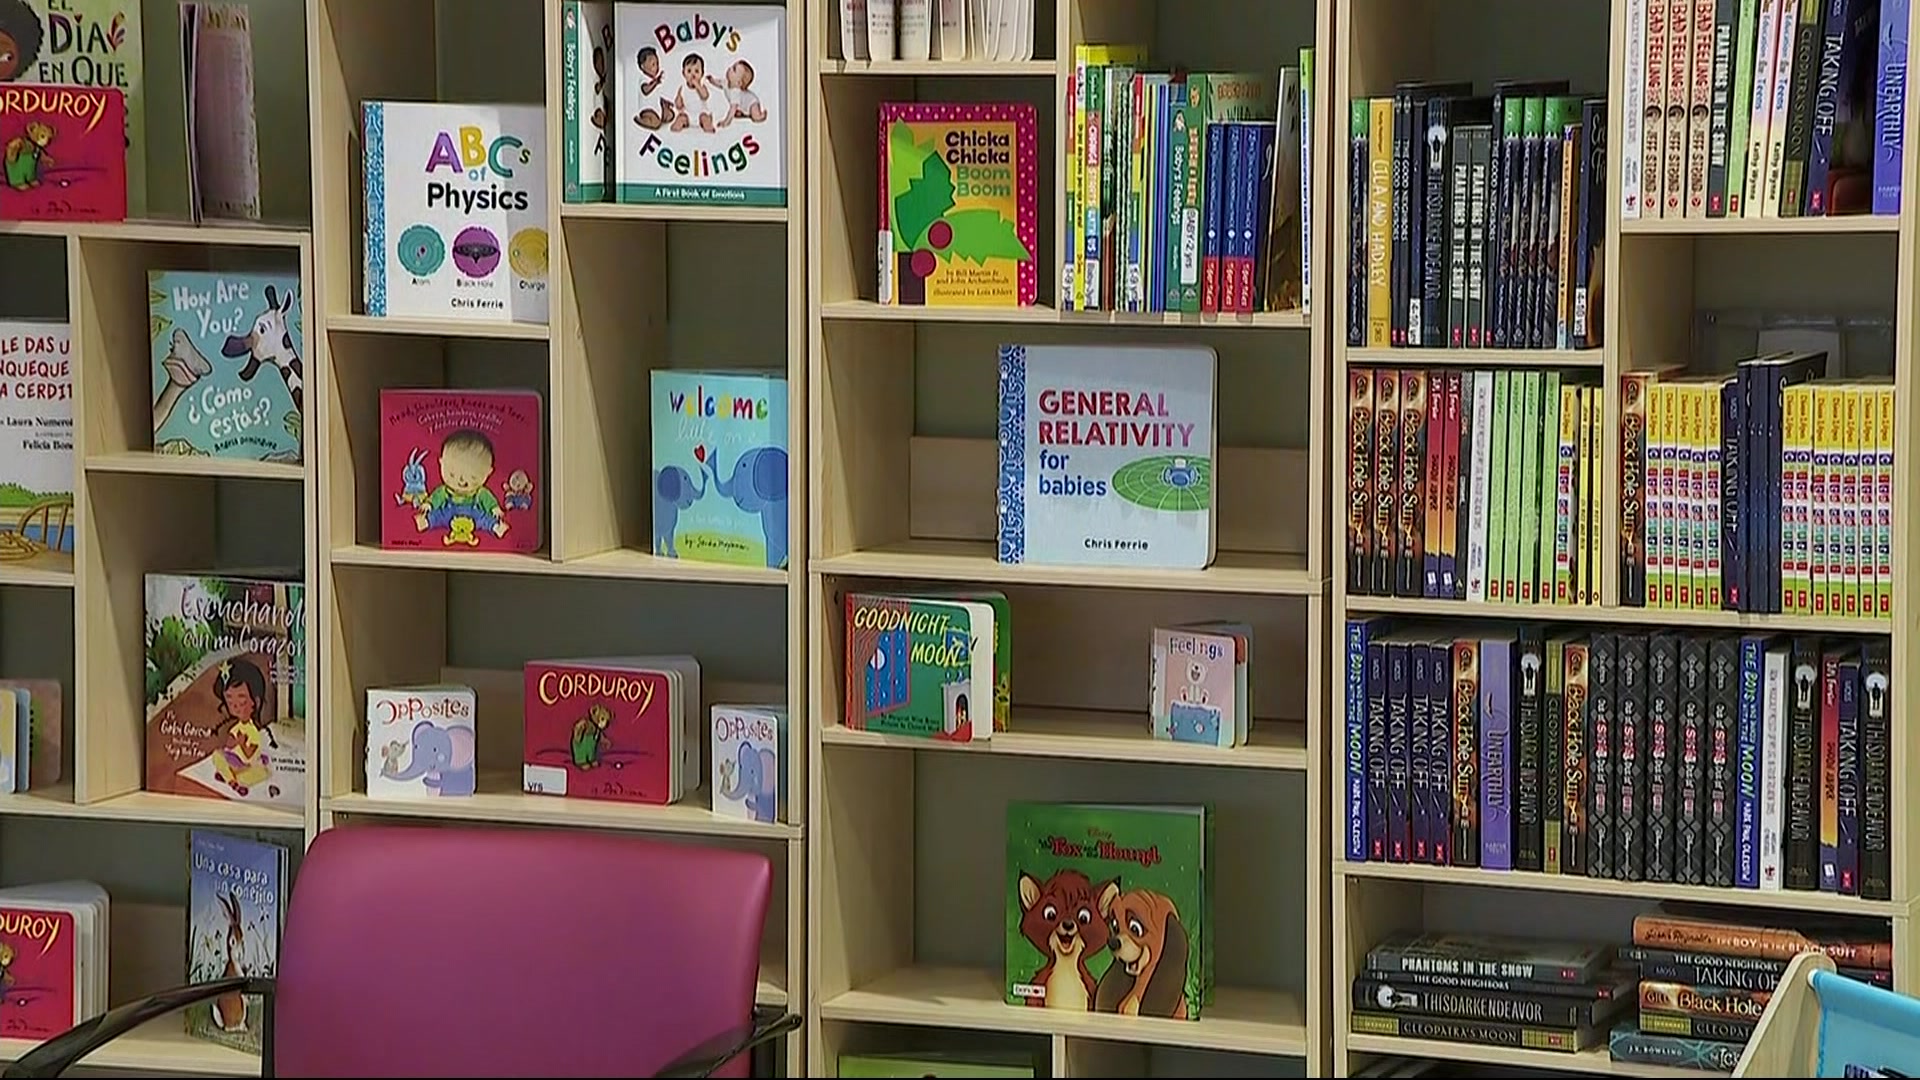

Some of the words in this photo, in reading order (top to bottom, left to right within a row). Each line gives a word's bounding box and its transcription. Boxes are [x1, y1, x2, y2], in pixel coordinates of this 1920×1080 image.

[1649, 7, 1663, 33] BAD
[654, 13, 741, 54] Baby's
[1648, 38, 1663, 88] FEELING
[1715, 25, 1730, 87] PHANTOMS
[1818, 32, 1844, 96] TAKING
[39, 62, 64, 84] EN
[71, 55, 128, 87] QUE
[1714, 92, 1728, 103] IN
[1755, 78, 1766, 110] Teens
[1881, 62, 1906, 149] UNEARTHLY
[0, 89, 106, 137] RDUROY
[1713, 110, 1727, 128] THE
[1815, 102, 1835, 136] OFF
[945, 131, 1010, 147] Chicka
[1712, 134, 1726, 166] SNOW
[639, 132, 760, 177] Feelings
[946, 148, 1010, 164] Chicka
[468, 167, 487, 181] of
[956, 165, 1011, 180] Boom
[427, 182, 528, 214] Physics
[662, 190, 680, 198] First
[681, 189, 699, 198] Book
[701, 190, 710, 199] of
[711, 191, 745, 200] Emotions
[956, 182, 1011, 197] Boom
[1370, 232, 1385, 288] HADLEY
[172, 286, 212, 311] How
[217, 279, 249, 305] Are
[450, 298, 474, 309] Chris
[477, 299, 503, 309] Ferrie
[197, 308, 243, 338] You?
[25, 336, 54, 354] DAS
[1038, 390, 1169, 417] GENERAL
[7, 416, 33, 427] Laura
[210, 398, 271, 438] estás?
[1353, 408, 1369, 452] Black
[1039, 421, 1195, 448] RELATIVITY
[1039, 449, 1069, 470] for
[1353, 454, 1369, 488] Hole
[1039, 474, 1107, 496] babies
[1351, 491, 1368, 523] Sun
[1084, 538, 1112, 549] Chris
[1115, 540, 1149, 550] Ferrie
[855, 607, 950, 635] GOODNIGHT
[183, 632, 209, 650] con
[214, 629, 234, 650] mi
[1169, 637, 1225, 659] Feelings
[911, 642, 960, 667] MOON
[539, 671, 656, 719] CORDUROY
[1368, 695, 1385, 752] TAKING
[1369, 757, 1385, 788] OFF
[527, 780, 544, 793] yrs
[194, 852, 215, 874] Una
[218, 859, 241, 880] casa
[244, 867, 268, 887] para
[230, 882, 275, 906] conejito
[1733, 937, 1757, 948] BOY
[1830, 947, 1856, 958] SUIT
[1401, 957, 1459, 973] PHANTOMS
[1463, 960, 1474, 974] IN
[1479, 961, 1497, 976] THE
[1501, 963, 1534, 979] SNOW
[1674, 954, 1697, 965] THE
[1699, 956, 1722, 966] GOOD
[1725, 958, 1778, 972] NEIGHBORS
[1695, 967, 1752, 988] TAKING
[1679, 990, 1721, 1013] Black
[1725, 992, 1763, 1016] Hole
[1403, 1023, 1476, 1039] CLEOPATRA'S
[1479, 1029, 1517, 1043] MOON
